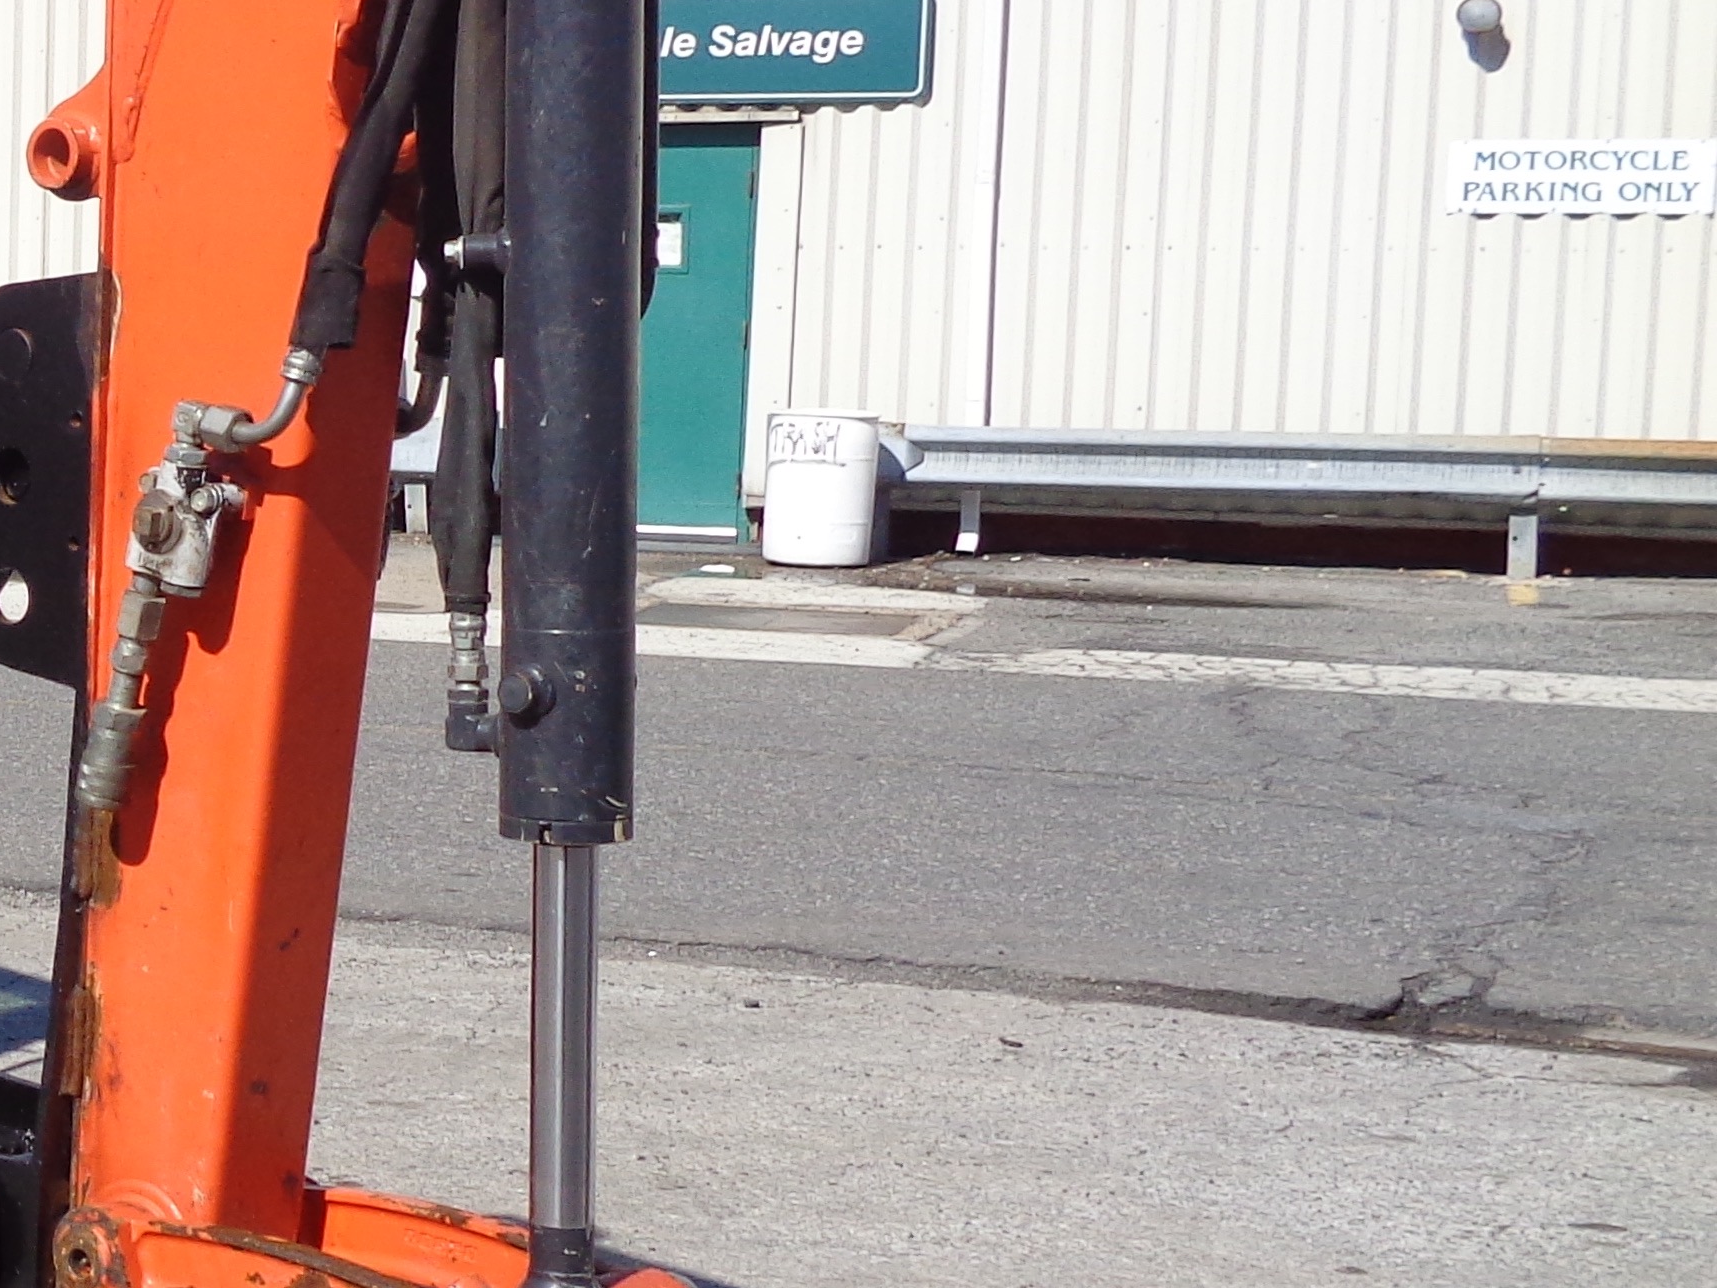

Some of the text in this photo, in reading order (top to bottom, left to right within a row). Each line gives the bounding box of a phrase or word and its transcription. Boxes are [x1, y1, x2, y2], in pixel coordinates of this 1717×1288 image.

[708, 24, 864, 64] Salvage
[1473, 150, 1691, 171] MOTORCYCLE
[1462, 181, 1701, 202] PARKING ONLY
